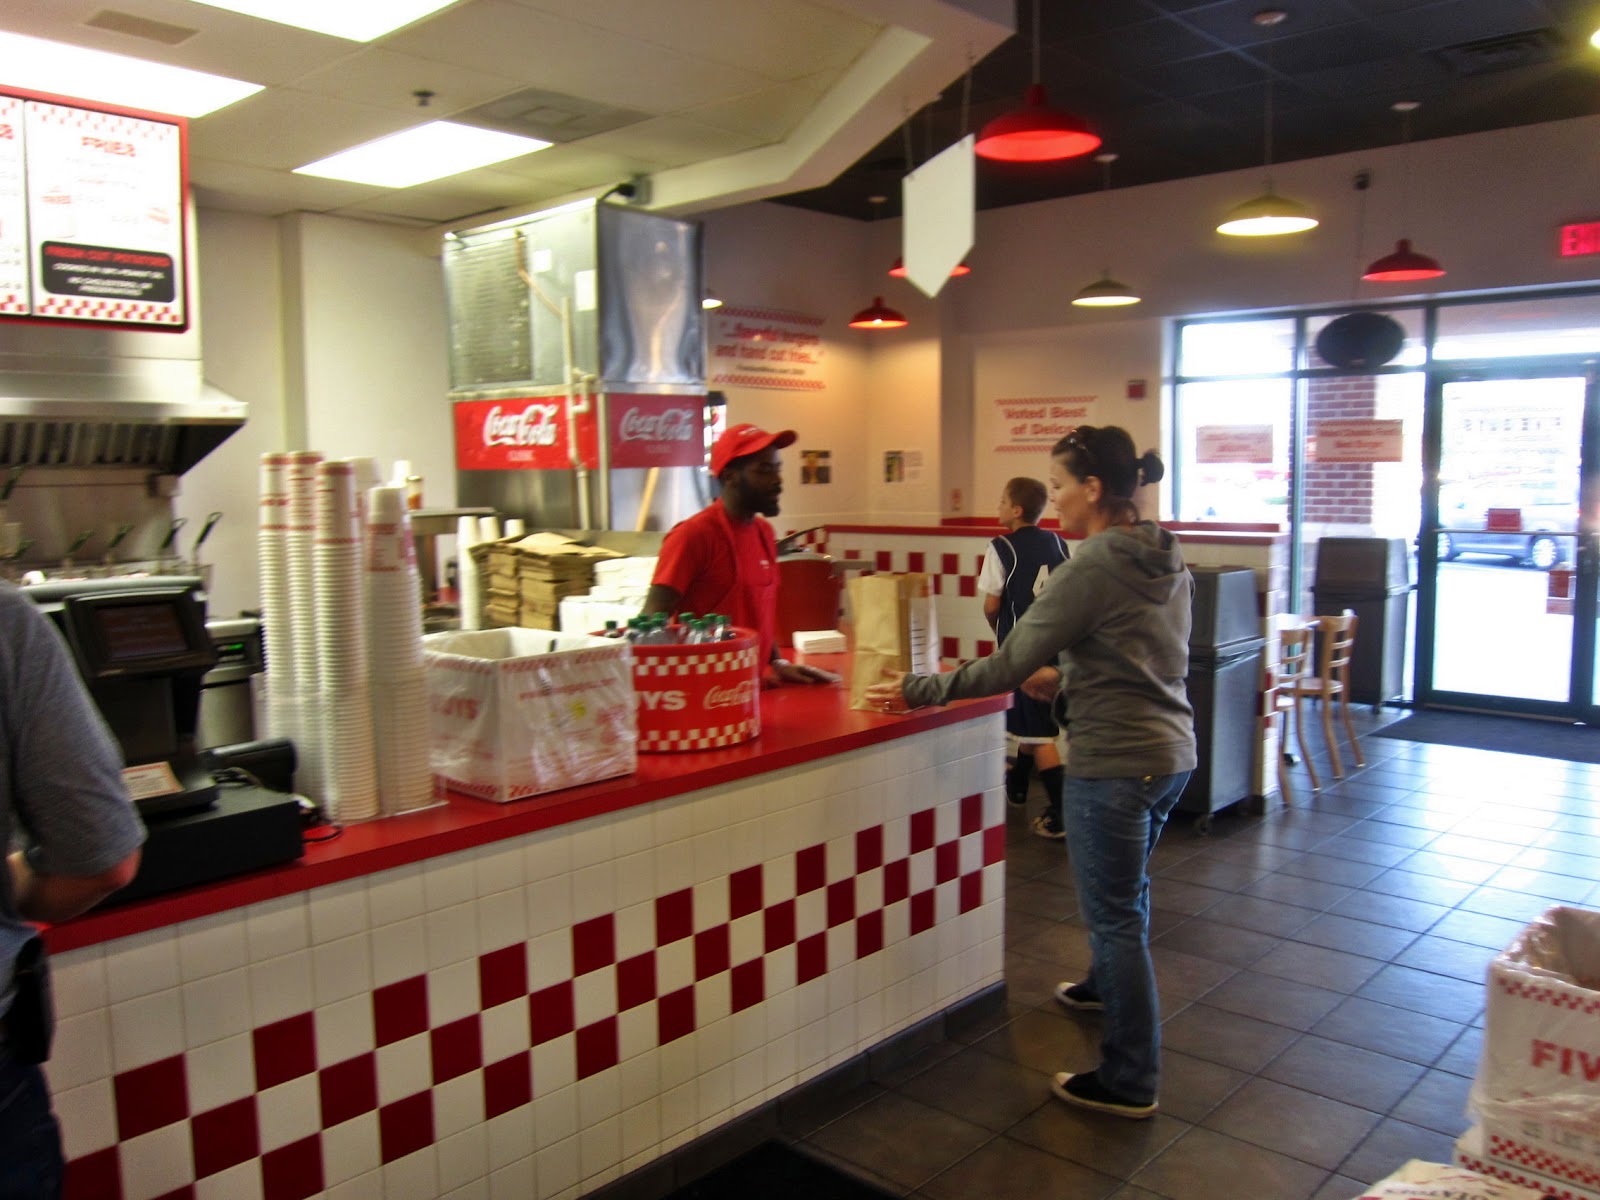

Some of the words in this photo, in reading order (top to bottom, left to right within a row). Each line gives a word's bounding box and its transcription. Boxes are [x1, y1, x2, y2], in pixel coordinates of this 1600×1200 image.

[81, 136, 137, 158] FRIES
[483, 403, 560, 446] Coca-Cola
[619, 406, 695, 441] Coca-Cola
[1049, 406, 1088, 418] Best
